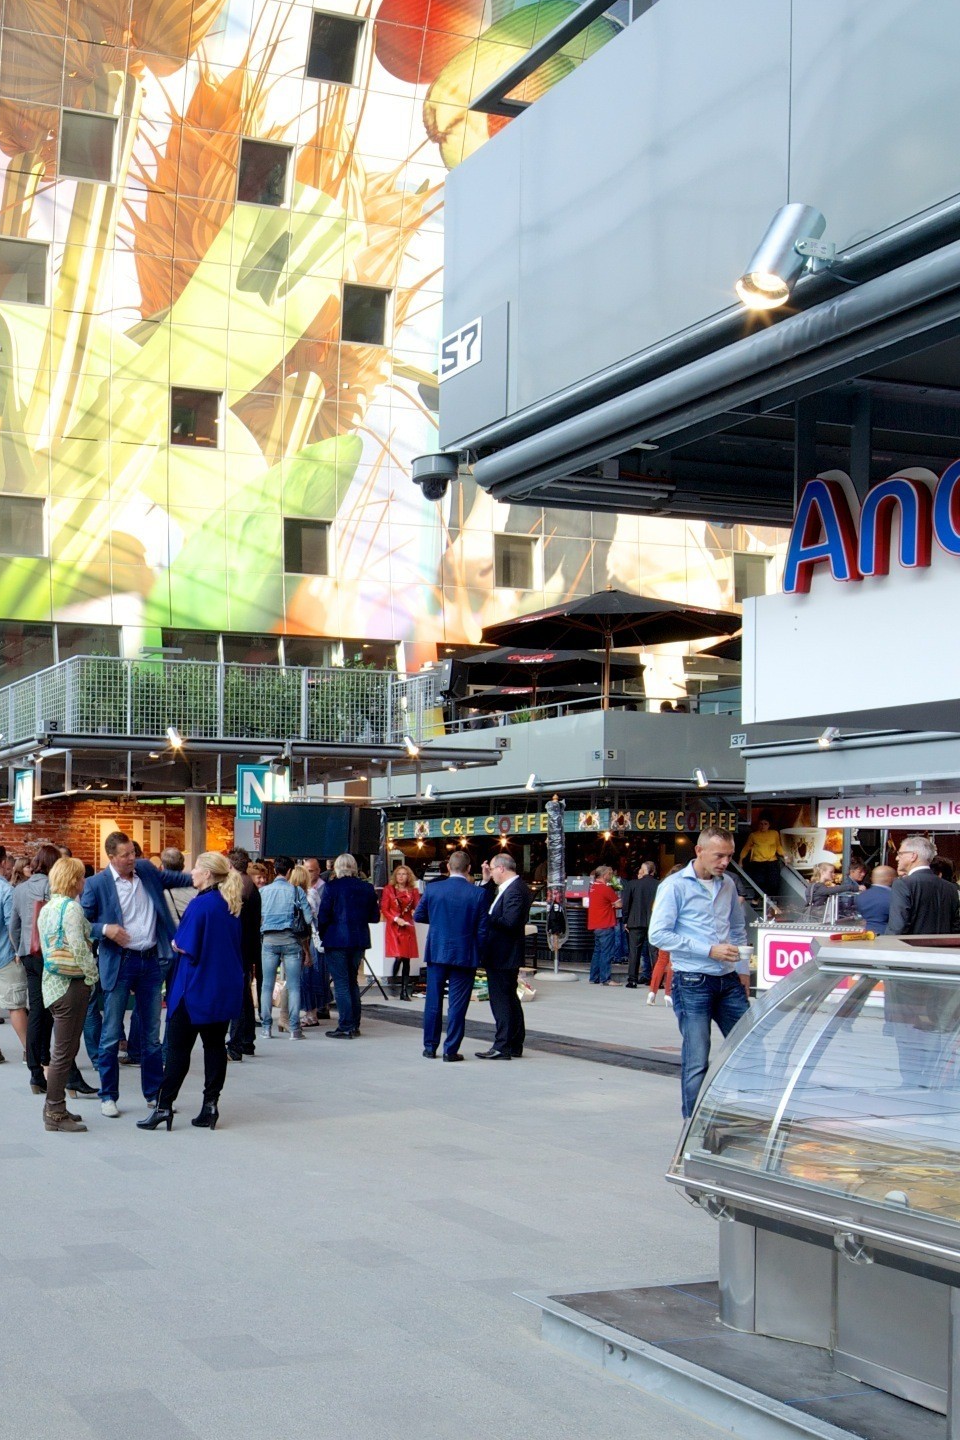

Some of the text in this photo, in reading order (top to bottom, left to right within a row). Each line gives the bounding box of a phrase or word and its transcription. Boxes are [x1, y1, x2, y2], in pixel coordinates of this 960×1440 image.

[441, 323, 478, 375] 57
[50, 721, 58, 731] 3
[500, 738, 507, 747] 3
[731, 735, 746, 745] 37
[242, 806, 262, 814] Natu
[827, 806, 860, 819] Echt
[866, 801, 942, 818] helemaal
[441, 813, 548, 835] C&E COFFE
[635, 810, 736, 831] C&E COFFEE
